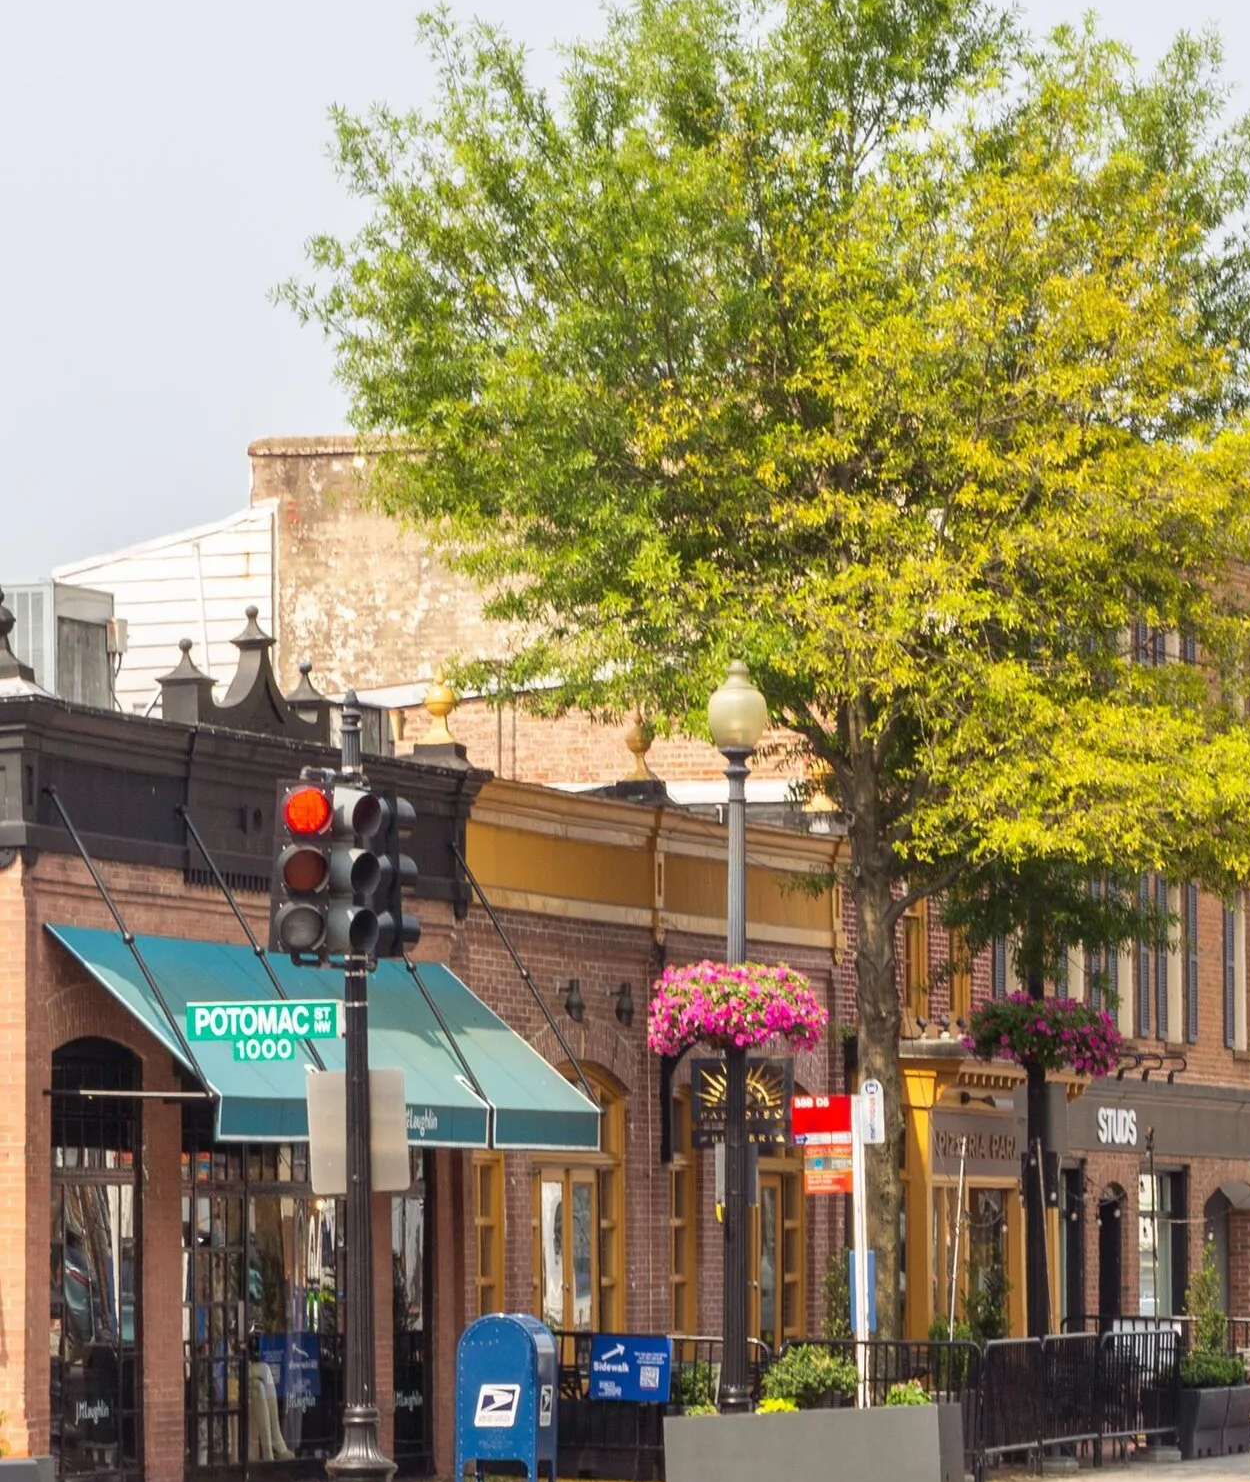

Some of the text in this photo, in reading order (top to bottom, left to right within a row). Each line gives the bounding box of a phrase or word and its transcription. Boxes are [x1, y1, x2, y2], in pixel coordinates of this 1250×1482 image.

[194, 1005, 331, 1037] POTOMAC ST
[313, 1020, 331, 1034] NW
[235, 1038, 292, 1059] 1000
[1097, 1107, 1138, 1147] STUDS
[593, 1361, 630, 1373] Sidewalk
